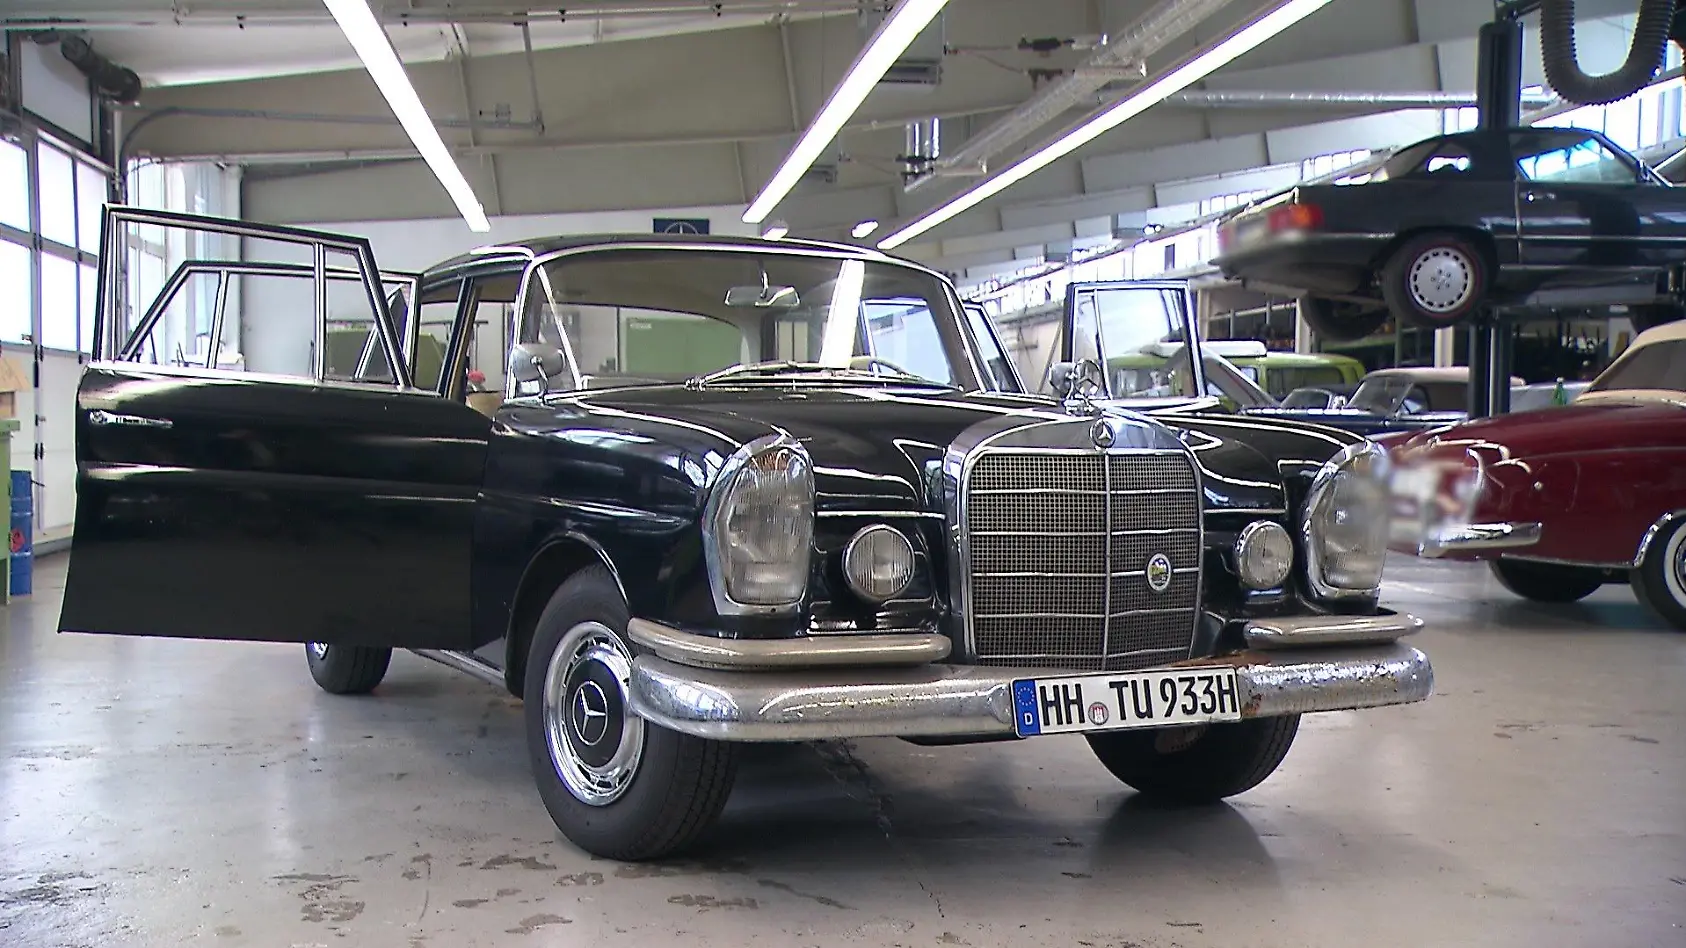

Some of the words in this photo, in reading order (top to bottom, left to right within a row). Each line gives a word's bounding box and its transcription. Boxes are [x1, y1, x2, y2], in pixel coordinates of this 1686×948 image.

[1039, 683, 1086, 726] HH
[1108, 678, 1154, 721] TU
[1159, 673, 1238, 718] 933H
[1023, 712, 1033, 726] D
